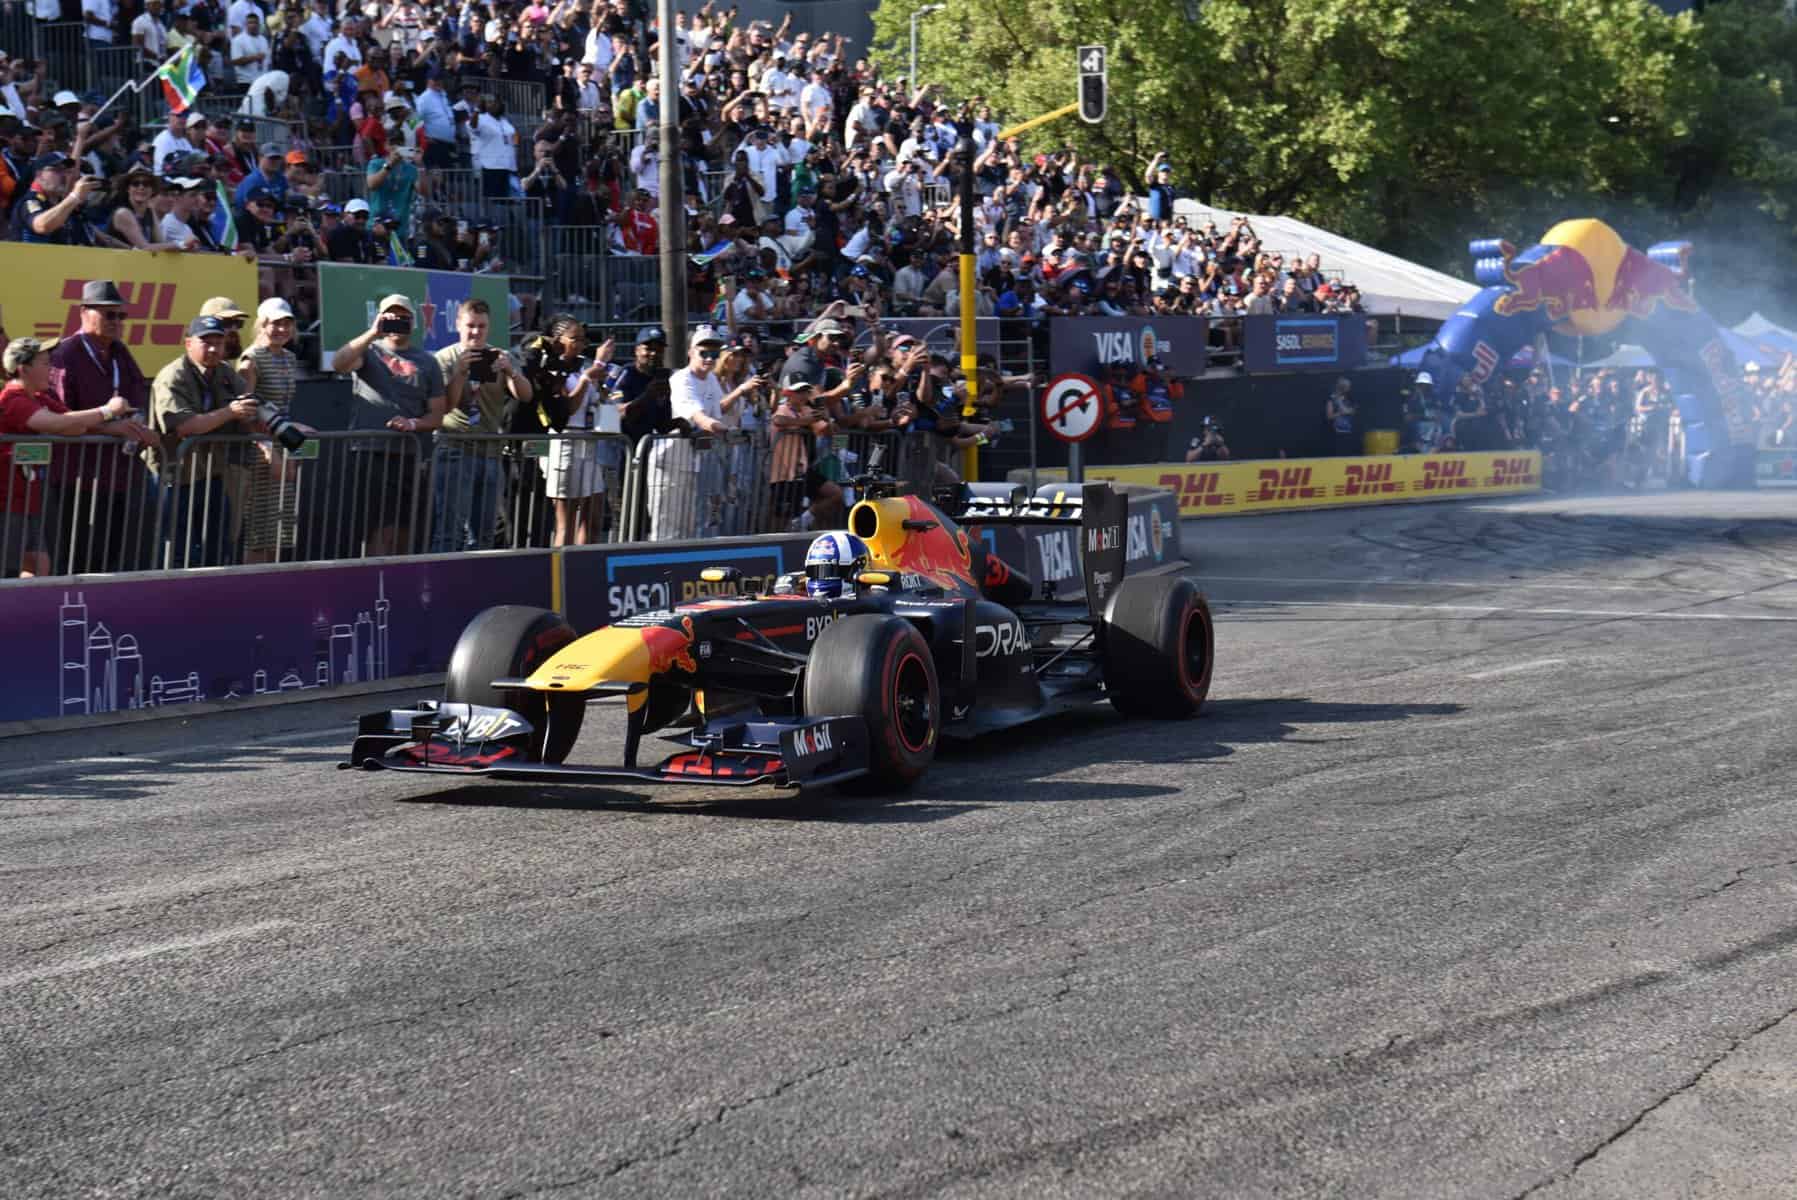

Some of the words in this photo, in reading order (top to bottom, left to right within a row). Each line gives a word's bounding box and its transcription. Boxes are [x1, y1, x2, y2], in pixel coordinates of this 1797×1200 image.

[1093, 331, 1134, 364] VISA
[1469, 340, 1499, 386] ull
[1258, 467, 1314, 501] DHL
[1345, 463, 1398, 496] DHL
[1423, 461, 1475, 490] DHL
[1493, 458, 1541, 486] DHL
[1159, 473, 1224, 508] DHL
[1126, 514, 1149, 562] ISA
[1036, 530, 1074, 581] VISA
[806, 609, 846, 641] BYI
[976, 620, 1031, 656] ORA
[793, 723, 832, 757] Mobil
